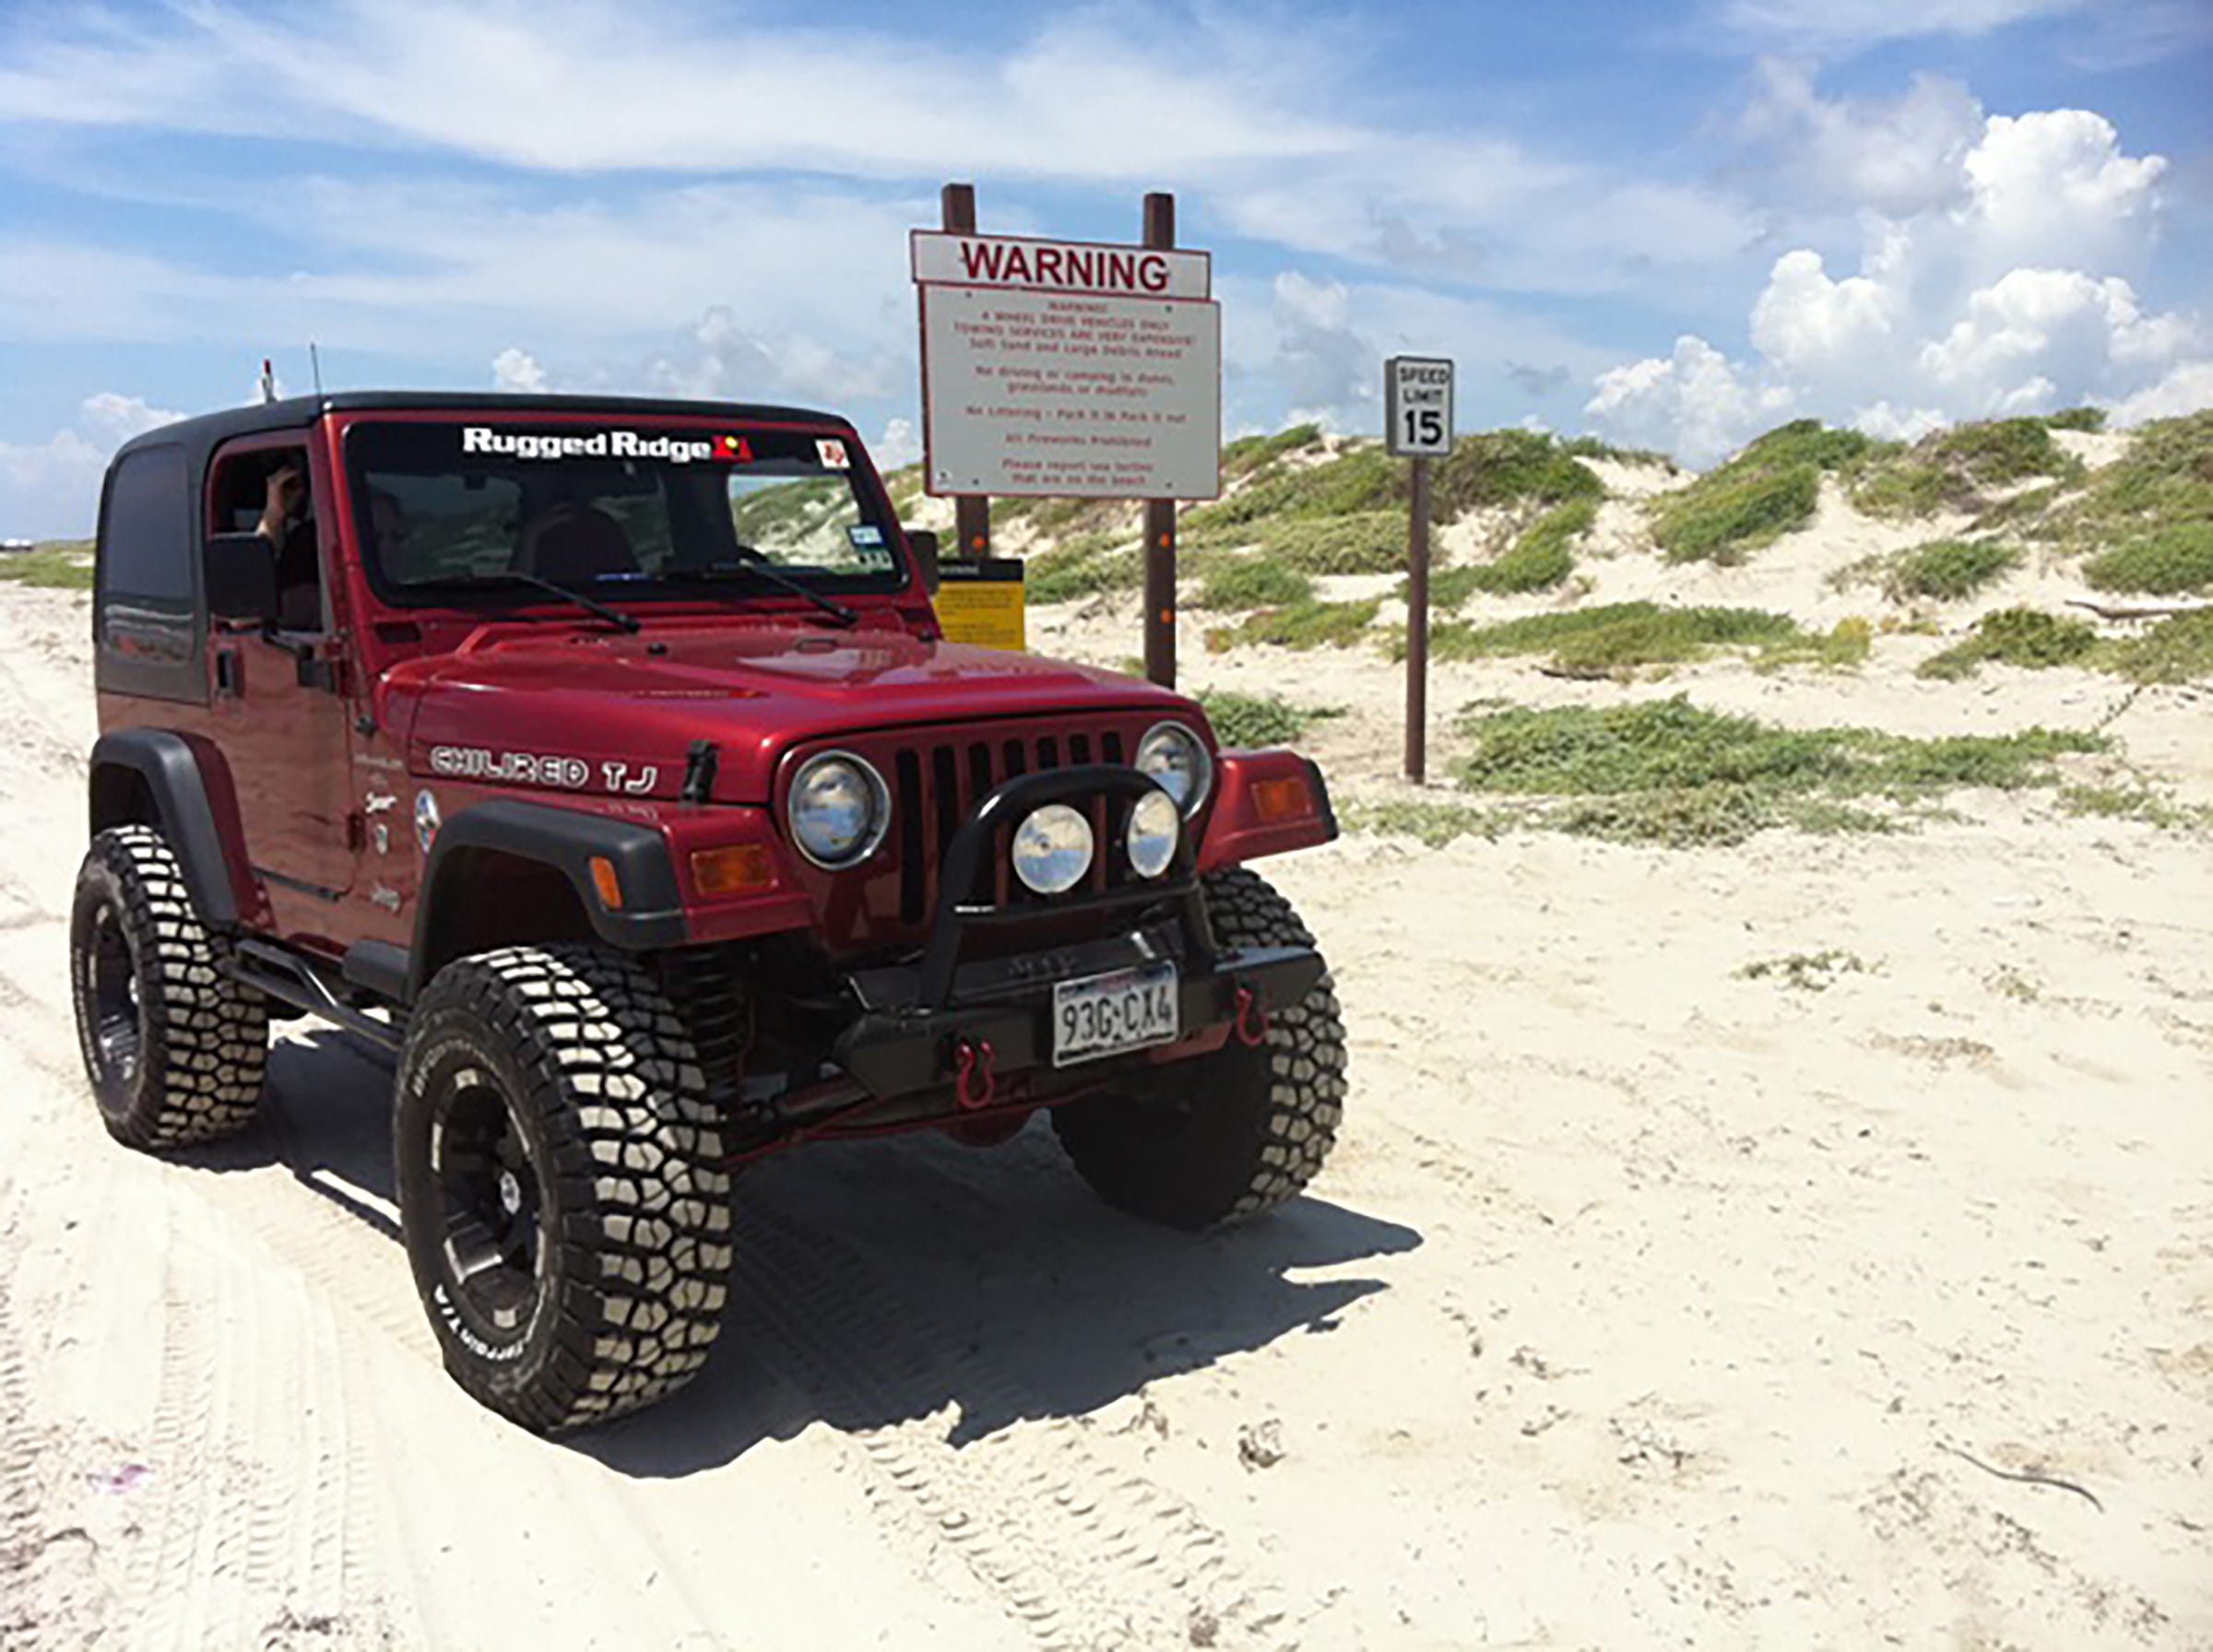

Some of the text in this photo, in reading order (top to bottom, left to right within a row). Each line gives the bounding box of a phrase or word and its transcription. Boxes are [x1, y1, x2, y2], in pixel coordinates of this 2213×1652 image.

[961, 241, 1169, 292] WARNING
[1400, 366, 1450, 384] SPEED
[1403, 387, 1443, 404] LIMIT
[1405, 409, 1443, 446] 15
[463, 427, 711, 463] Rugged Ridge
[602, 762, 658, 795] TJ
